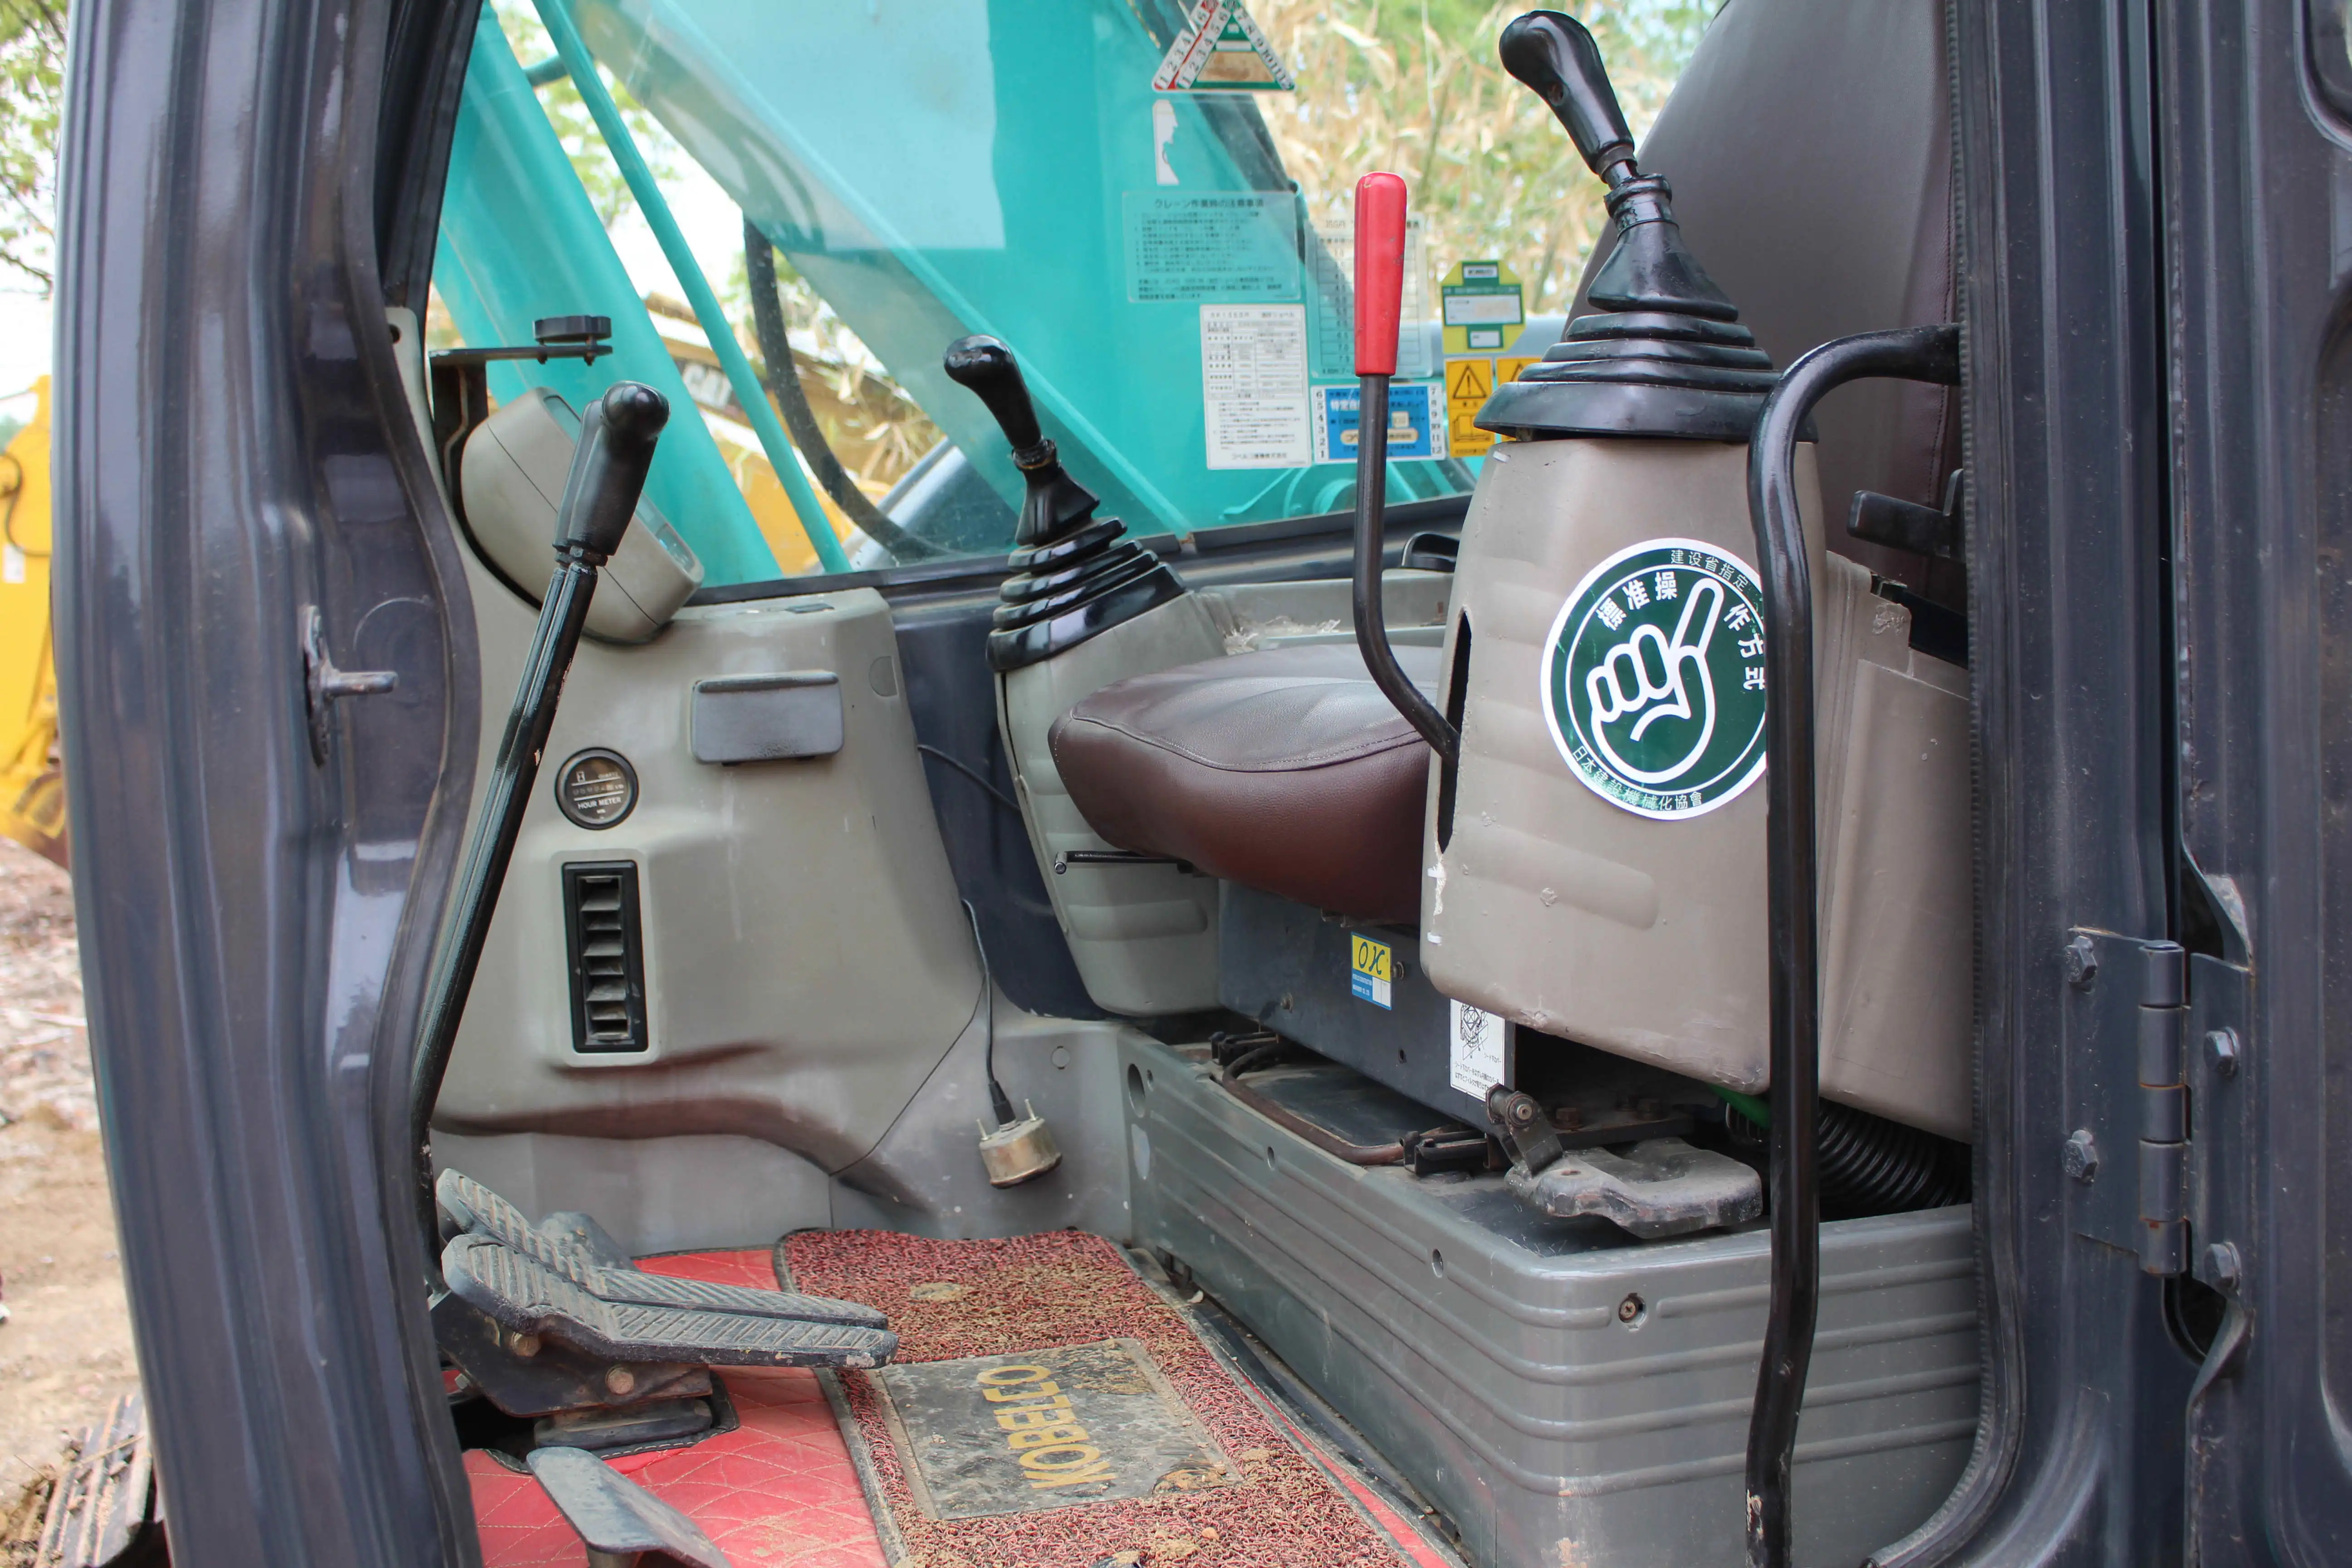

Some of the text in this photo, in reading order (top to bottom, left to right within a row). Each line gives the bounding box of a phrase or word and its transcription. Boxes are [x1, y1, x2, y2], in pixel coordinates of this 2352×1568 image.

[578, 797, 622, 809] HOUR METER
[1358, 941, 1385, 975] OK
[976, 1365, 1117, 1489] KOBELCO
